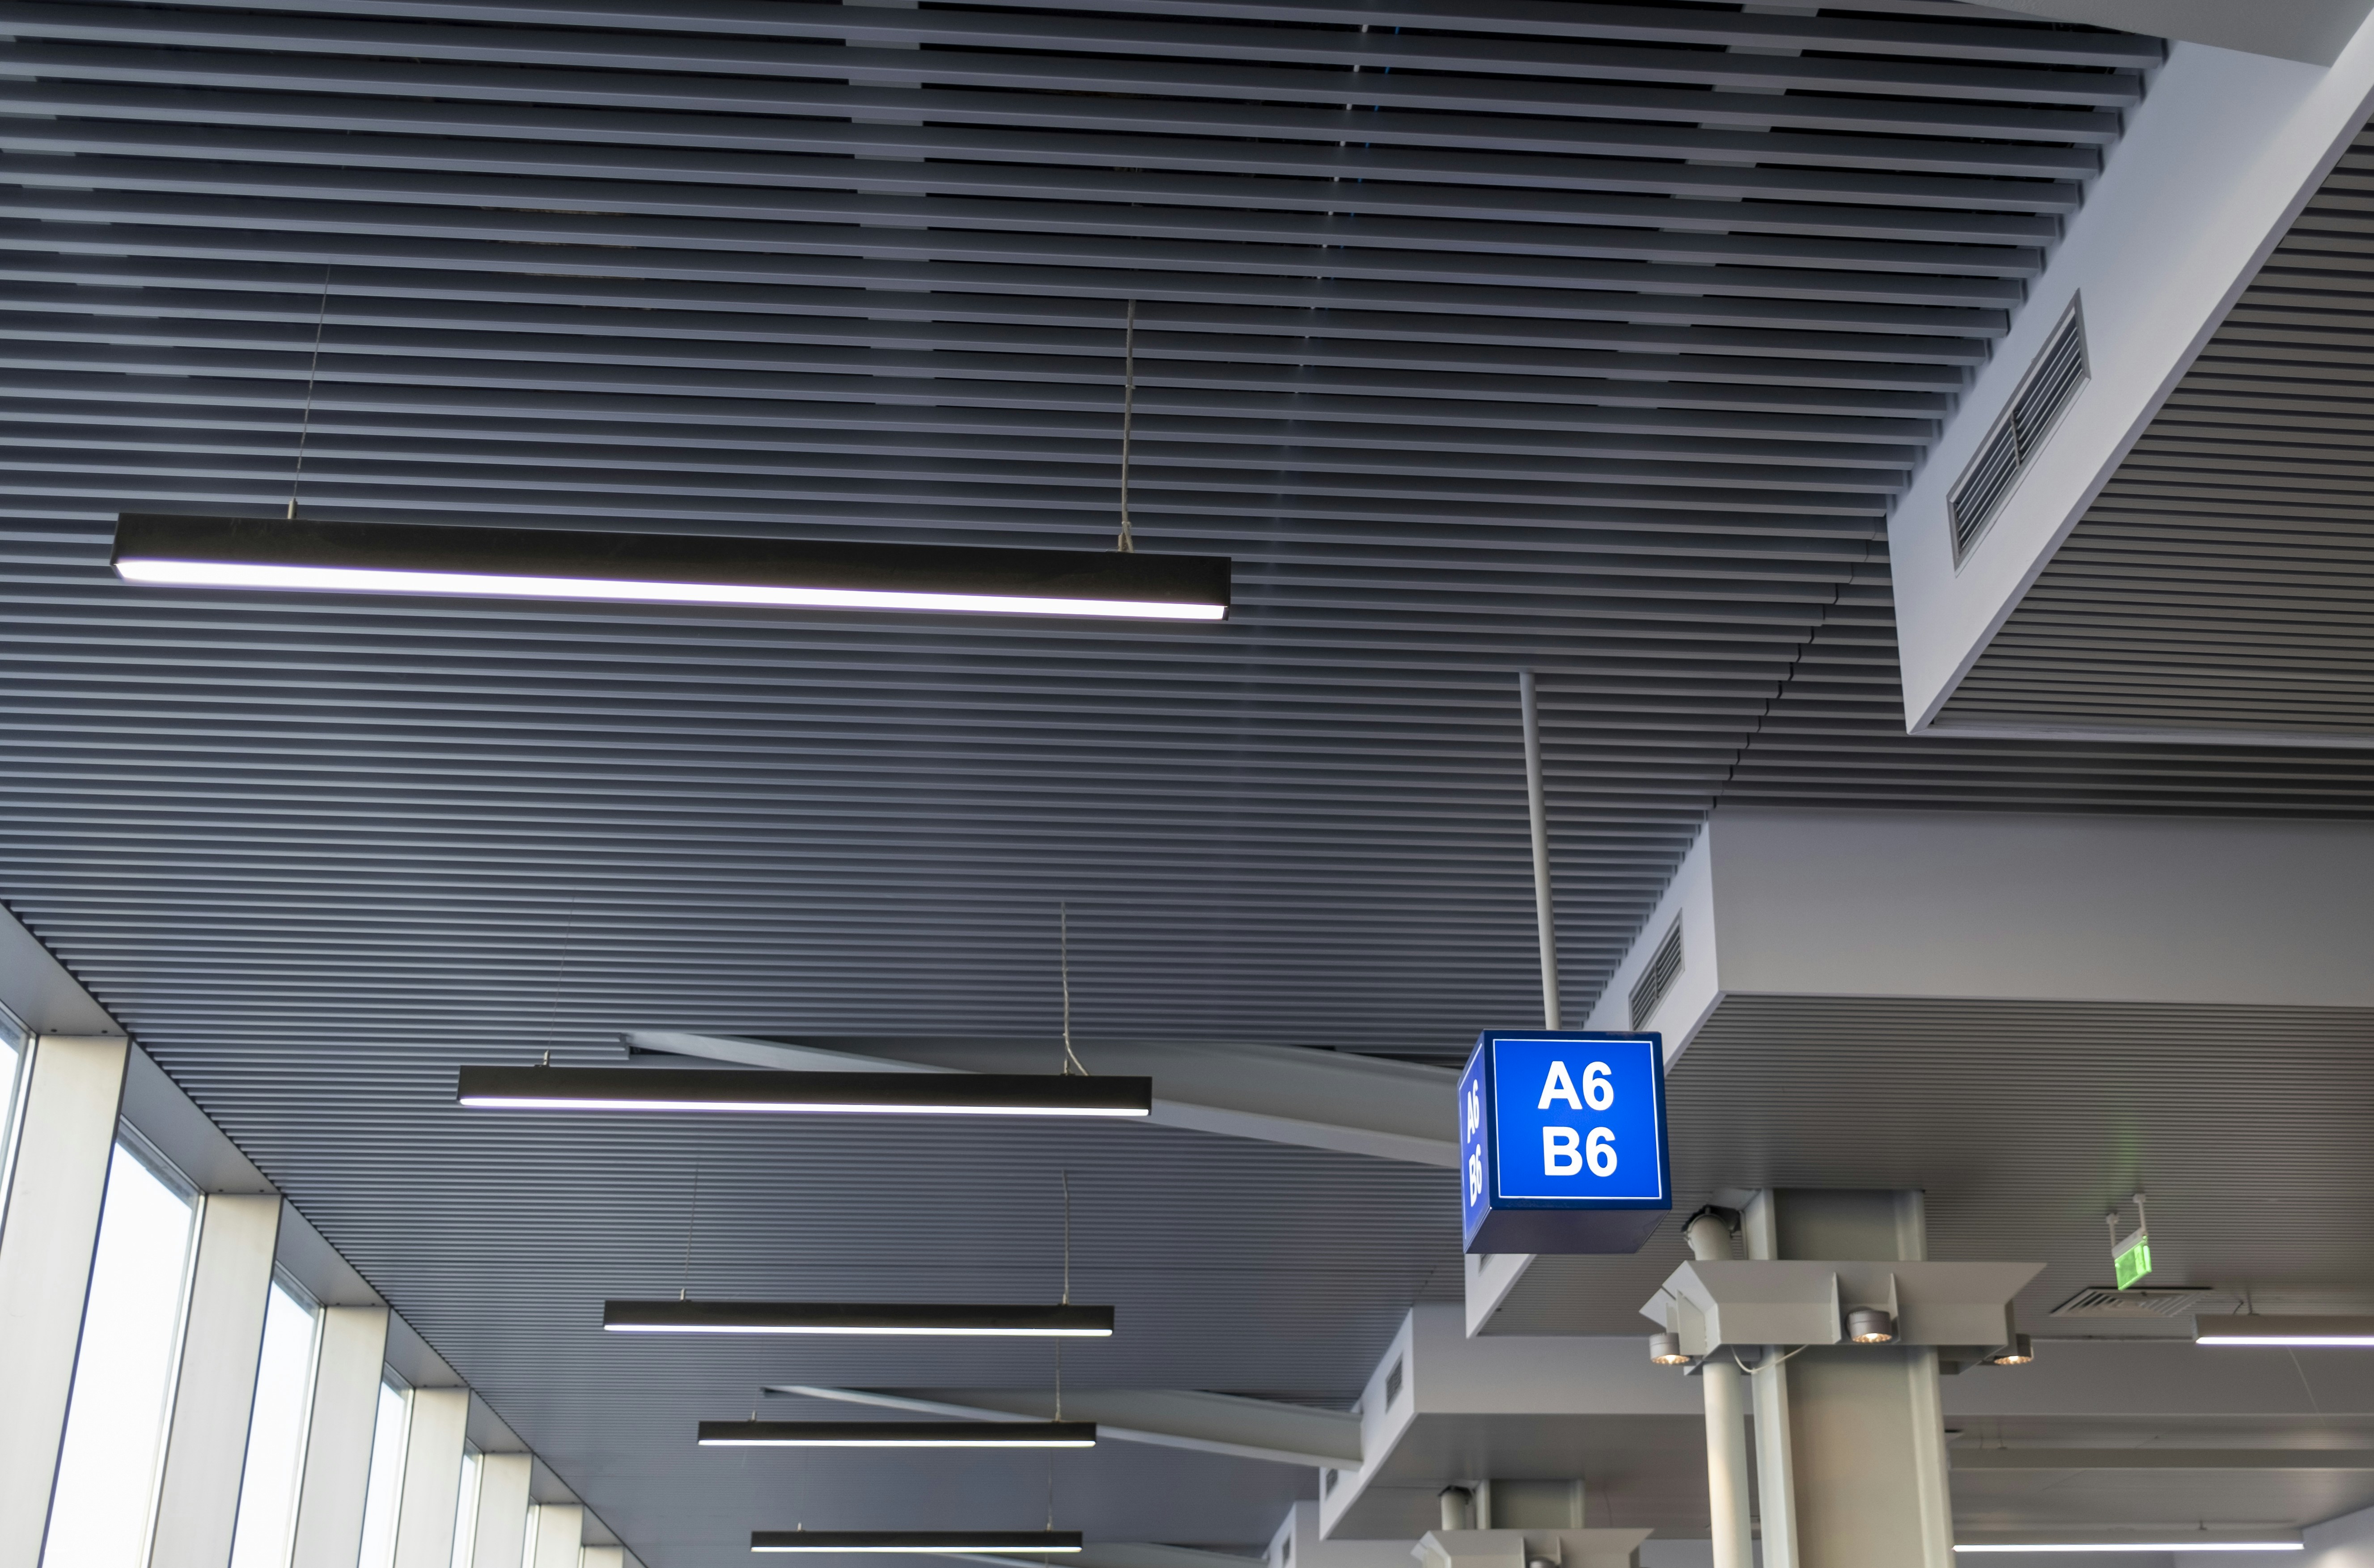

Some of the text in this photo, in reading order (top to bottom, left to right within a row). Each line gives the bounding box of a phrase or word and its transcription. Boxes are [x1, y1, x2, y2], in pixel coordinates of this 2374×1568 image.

[1467, 1079, 1480, 1144] A6
[1538, 1061, 1614, 1110] A6
[1469, 1144, 1482, 1207] B6
[1543, 1126, 1617, 1177] B6
